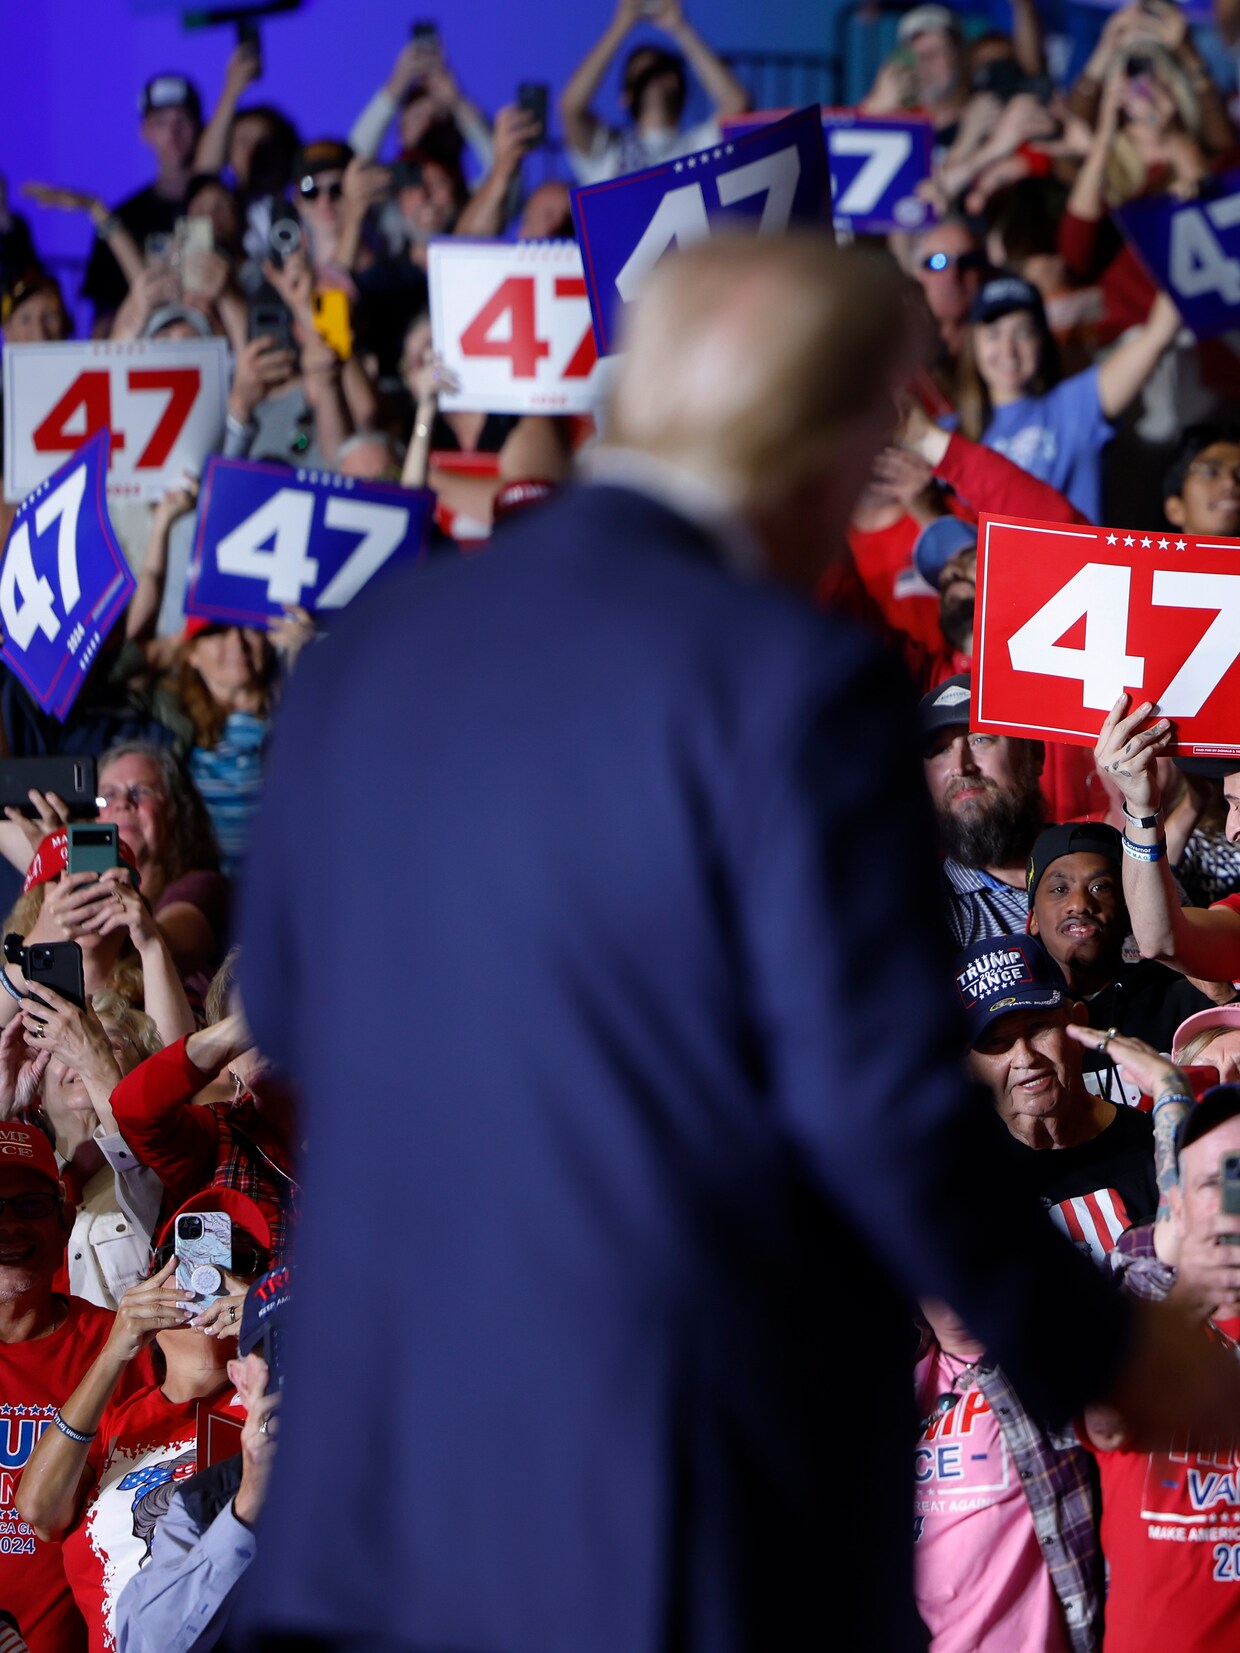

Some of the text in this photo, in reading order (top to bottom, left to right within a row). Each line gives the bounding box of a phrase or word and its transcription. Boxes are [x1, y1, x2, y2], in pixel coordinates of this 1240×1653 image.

[829, 129, 912, 215] 7
[459, 276, 602, 380] 47
[32, 368, 201, 471] 47
[0, 462, 88, 653] 47
[216, 487, 410, 610] 47
[956, 951, 1021, 986] TRUMP
[968, 968, 1023, 998] VANCE
[979, 966, 1003, 981] 2024
[1, 1536, 36, 1554] 024
[1148, 1523, 1187, 1543] MAKE
